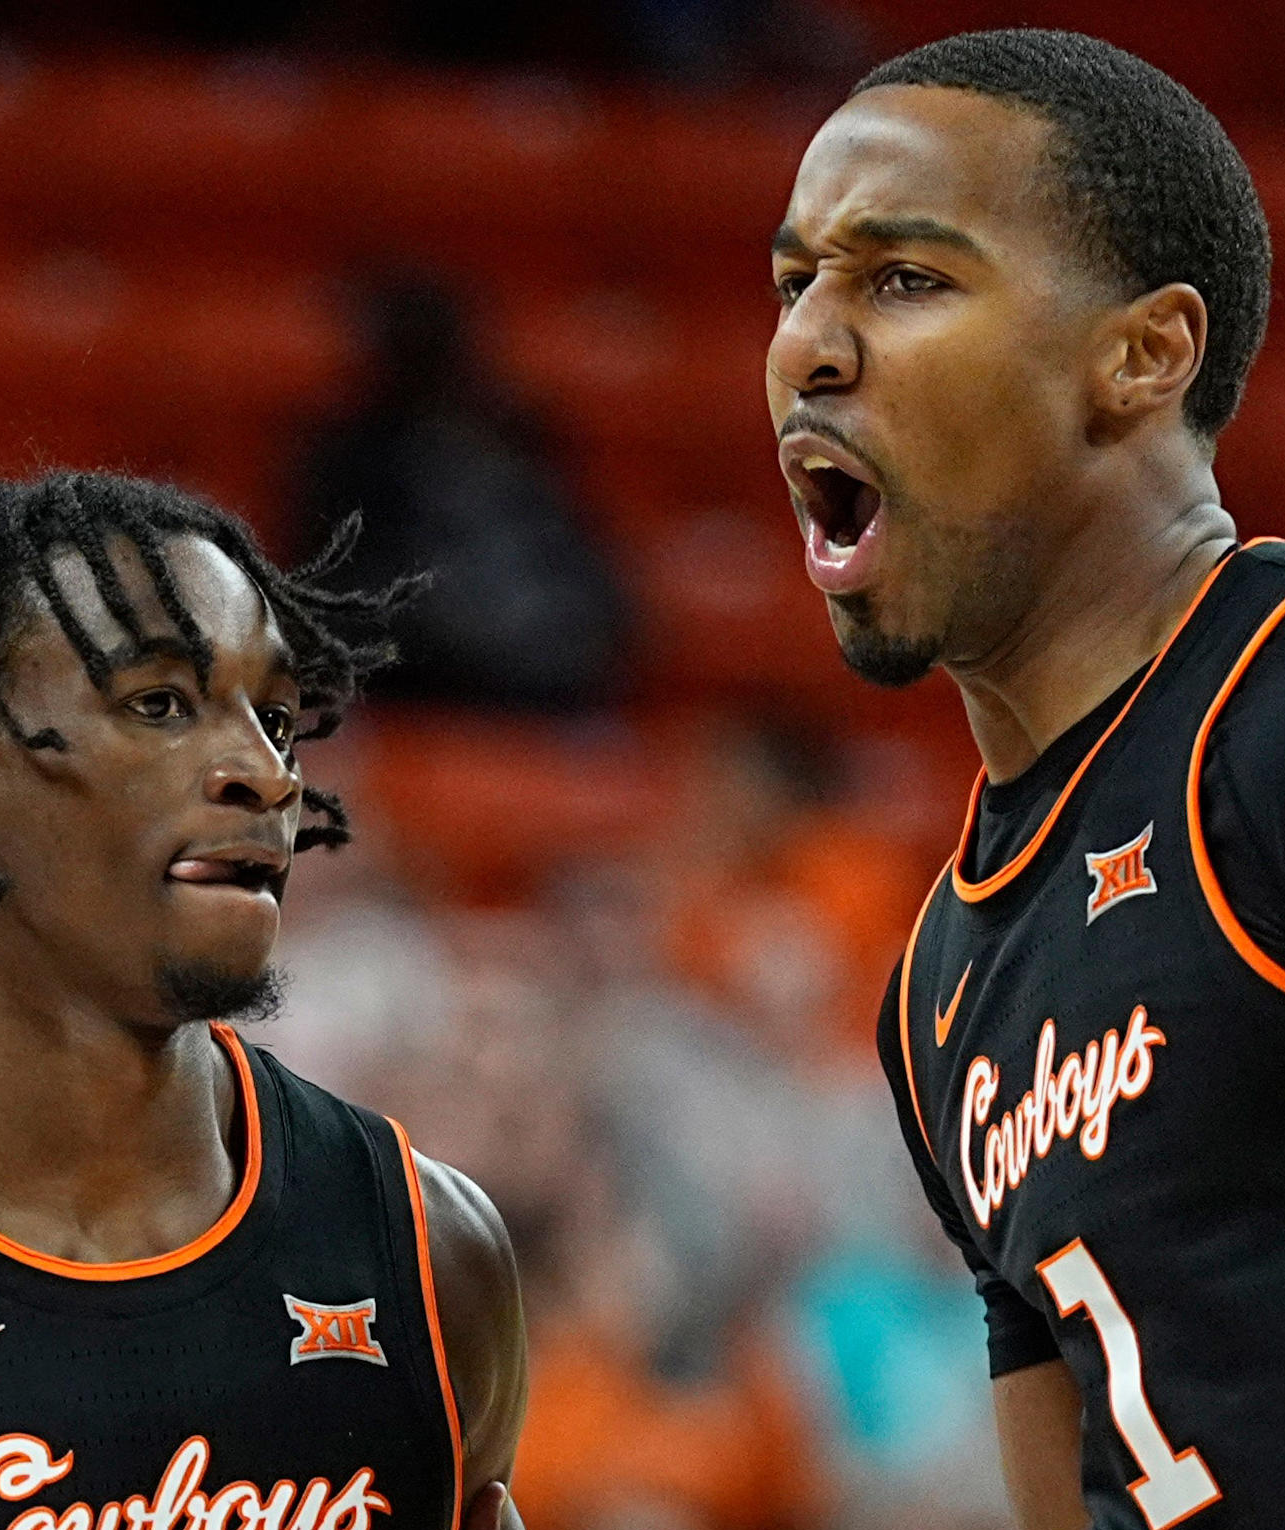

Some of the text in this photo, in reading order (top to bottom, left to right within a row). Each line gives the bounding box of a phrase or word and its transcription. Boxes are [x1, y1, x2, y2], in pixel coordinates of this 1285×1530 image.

[1090, 831, 1152, 912] XII
[960, 1004, 1167, 1229] Cowboys
[291, 1302, 382, 1358] XII
